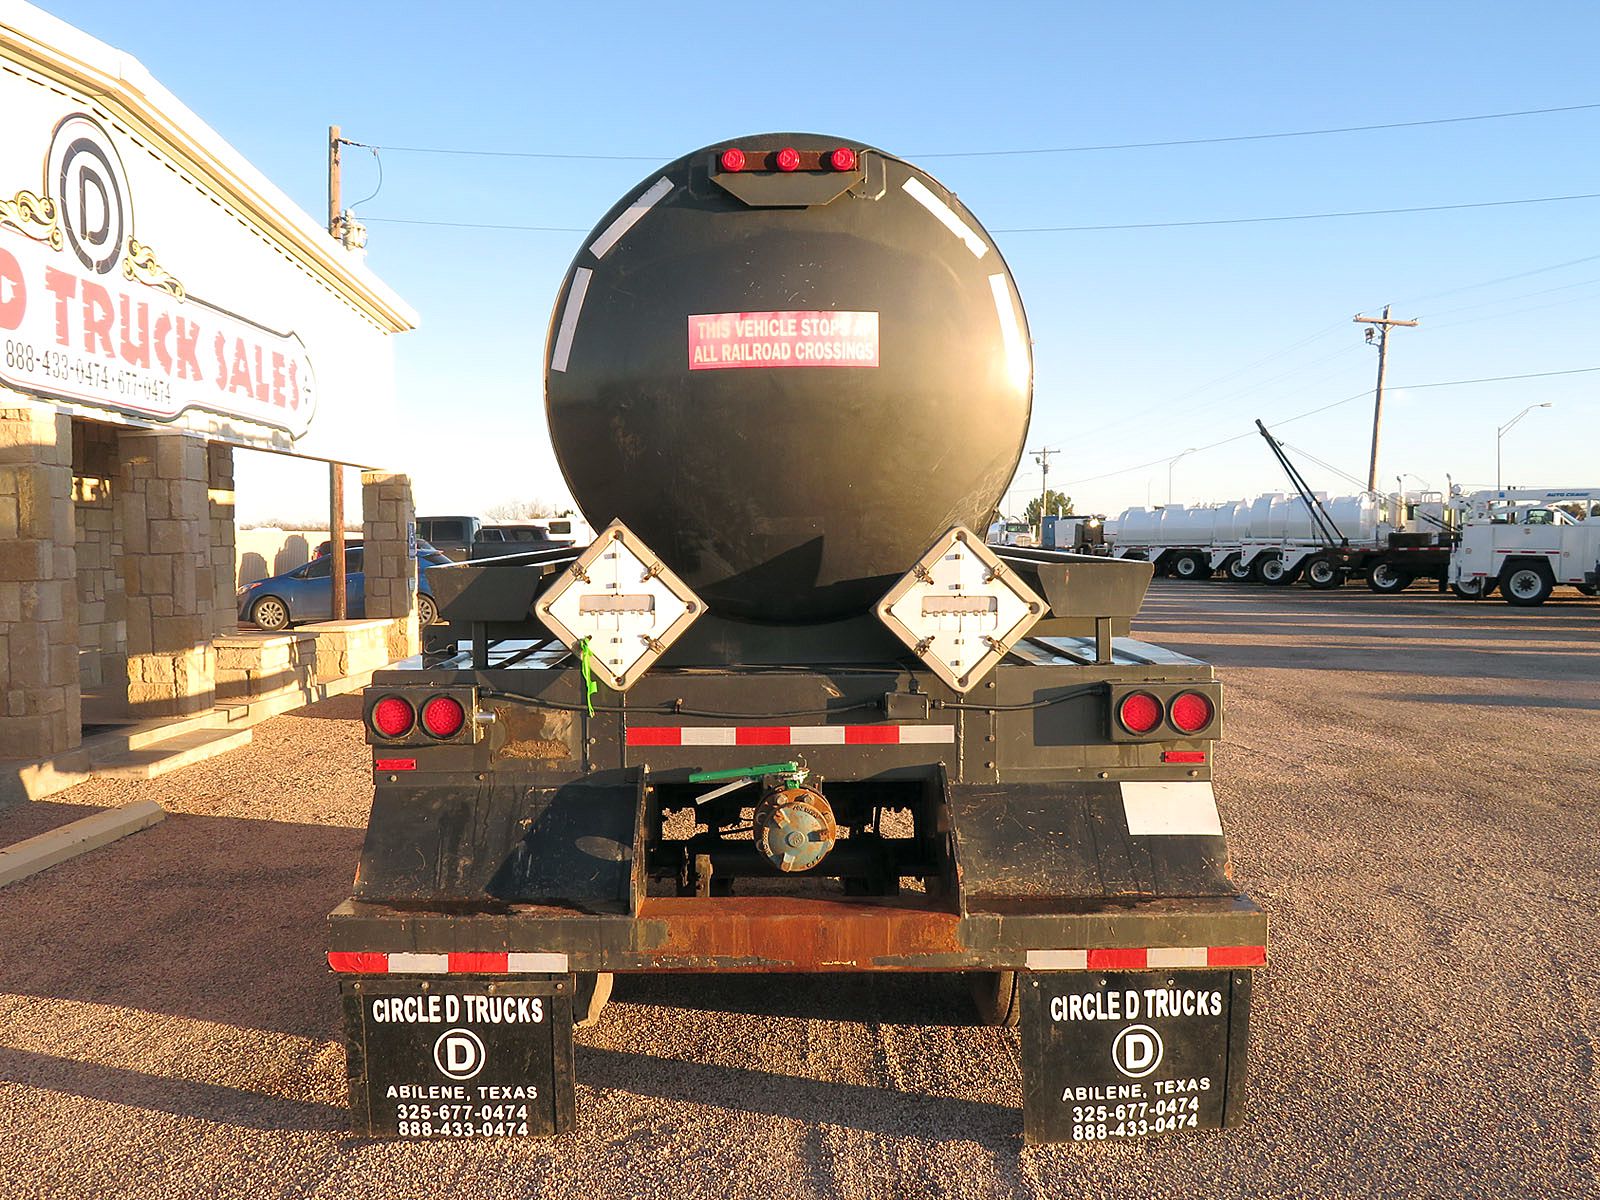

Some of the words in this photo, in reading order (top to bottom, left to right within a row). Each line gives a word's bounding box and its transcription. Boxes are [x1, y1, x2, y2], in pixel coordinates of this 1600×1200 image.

[45, 265, 204, 382] TRUCK
[214, 330, 300, 411] SALES
[697, 321, 731, 339] THIS
[735, 319, 797, 337] VEHICLE
[801, 319, 850, 337] STOPS
[854, 319, 874, 337] A
[693, 345, 718, 363] ALL
[721, 343, 791, 361] RAILROAD
[795, 342, 874, 361] CROSSINGS
[372, 995, 441, 1023] CIRCLE
[445, 994, 460, 1023] D
[463, 995, 544, 1024] TRUCKS
[1050, 991, 1121, 1022] CIRCLE
[1125, 990, 1140, 1020] D
[1143, 988, 1222, 1018] TRUCKS
[446, 1037, 476, 1071] D
[1125, 1033, 1154, 1069] D
[386, 1085, 471, 1101] ABILENE,
[477, 1085, 538, 1100] TEXAS
[1062, 1083, 1148, 1101] ABILENE,
[1153, 1077, 1211, 1096] TEXAS
[397, 1104, 528, 1120] 325-677-0474
[1072, 1096, 1199, 1123] 325-677-0474
[398, 1121, 529, 1137] 888-433-0474
[1072, 1113, 1198, 1141] 888-433-0474
